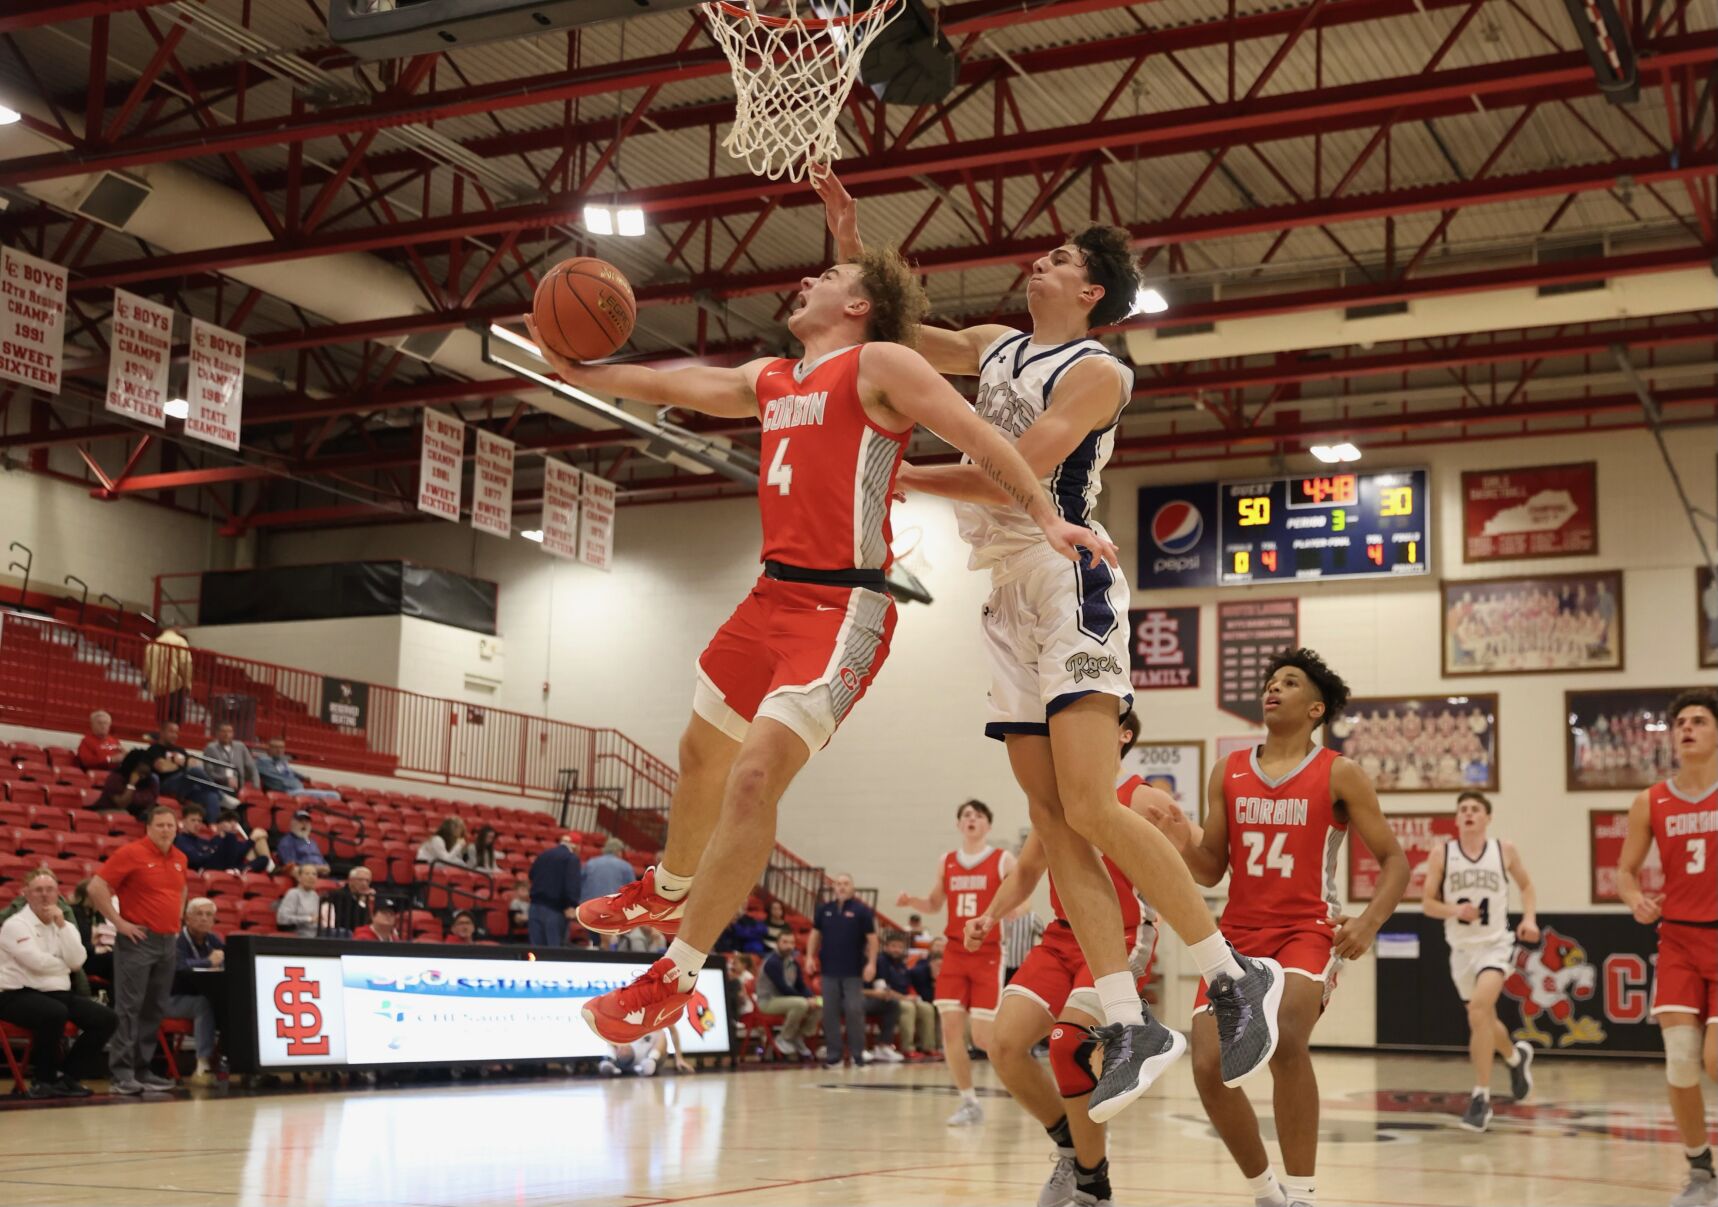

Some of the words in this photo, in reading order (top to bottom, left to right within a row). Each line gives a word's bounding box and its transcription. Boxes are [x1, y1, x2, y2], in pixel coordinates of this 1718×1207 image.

[24, 264, 64, 292] BOYS
[7, 299, 54, 327] CHAMPS
[133, 305, 169, 332] BOYS
[15, 323, 45, 343] 1991
[3, 341, 54, 368] SWEET
[119, 339, 161, 363] CHAMPS
[210, 334, 242, 358] BOYS
[0, 356, 58, 385] SIXTEEN
[109, 391, 163, 419] SIXTEEN
[201, 406, 227, 426] STATE
[762, 391, 828, 433] CORBIN
[187, 417, 237, 443] CHAMPIONS
[438, 421, 461, 441] BOYS
[426, 448, 456, 469] CHAMPS
[489, 441, 513, 461] BOYS
[767, 437, 793, 496] 4
[425, 482, 456, 503] SWEET
[1302, 473, 1357, 504] 4:48
[421, 494, 458, 515] SIXTEEN
[1238, 496, 1271, 526] 50
[1379, 486, 1413, 517] 30
[1331, 509, 1346, 532] 3
[1234, 551, 1250, 575] 0
[1261, 550, 1277, 572] 4
[1367, 543, 1384, 566] 4
[1408, 541, 1417, 564] 1
[1153, 556, 1200, 575] pepsi
[1131, 669, 1191, 687] FAMILY
[1139, 748, 1181, 765] 2005
[1235, 796, 1308, 826] CORBIN
[1664, 810, 1718, 838] CORBI
[1241, 831, 1295, 879] 24
[1685, 838, 1706, 875] 3
[956, 893, 977, 917] 15
